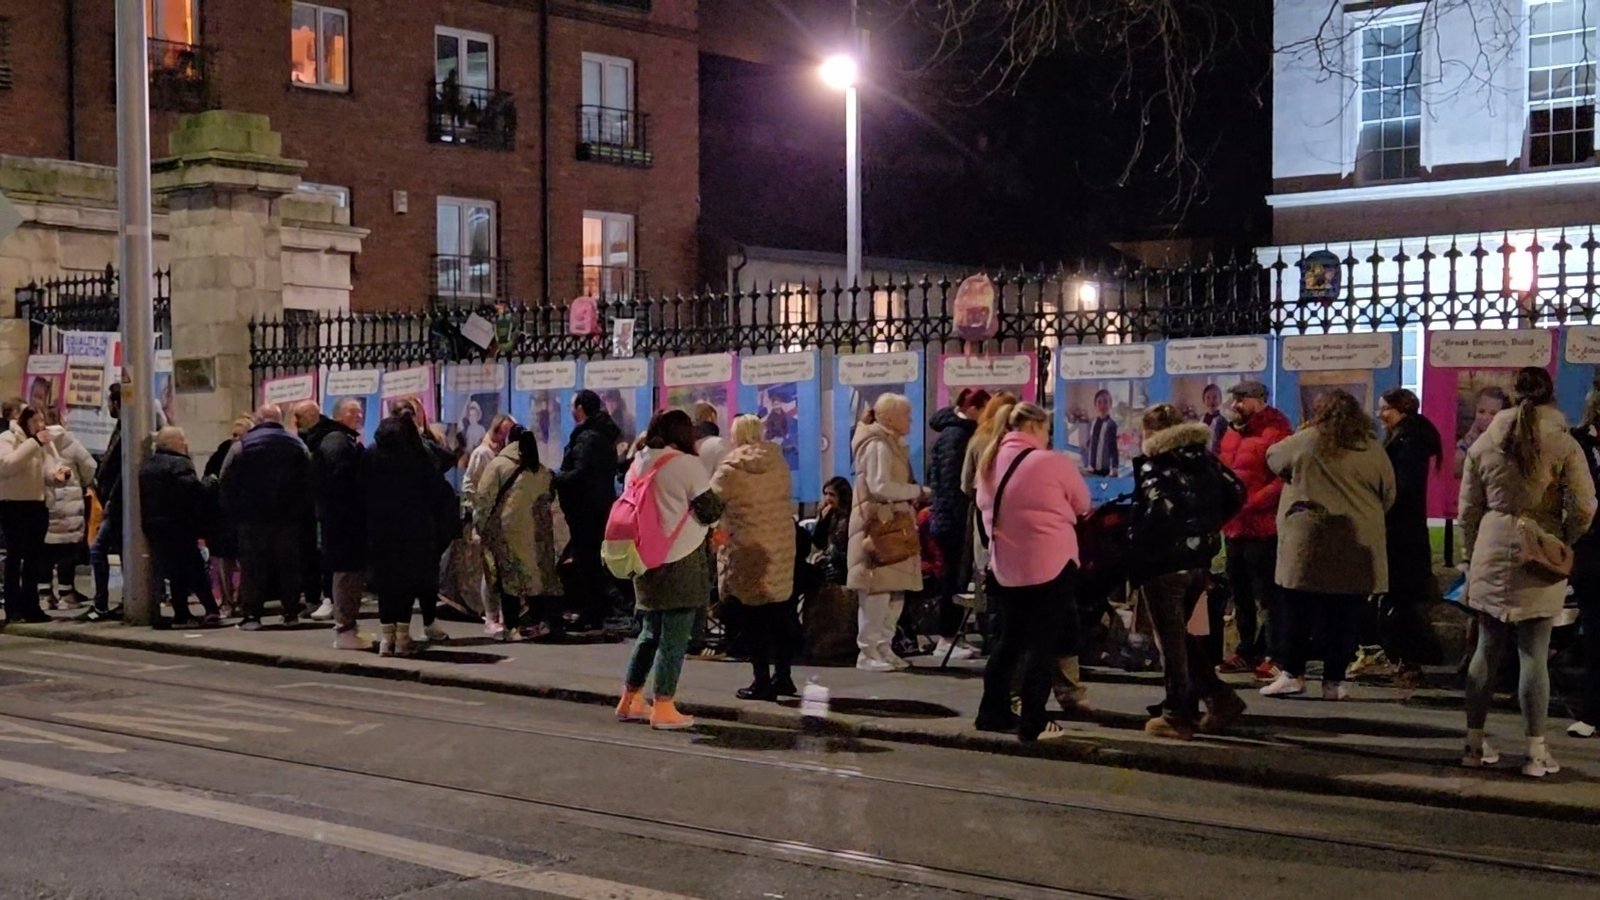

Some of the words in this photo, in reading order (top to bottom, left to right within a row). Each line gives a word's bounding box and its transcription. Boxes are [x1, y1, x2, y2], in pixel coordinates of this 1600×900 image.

[66, 335, 97, 346] EQUALITY
[98, 335, 108, 346] IN
[1511, 337, 1535, 346] Build
[66, 346, 106, 357] EDUCATION
